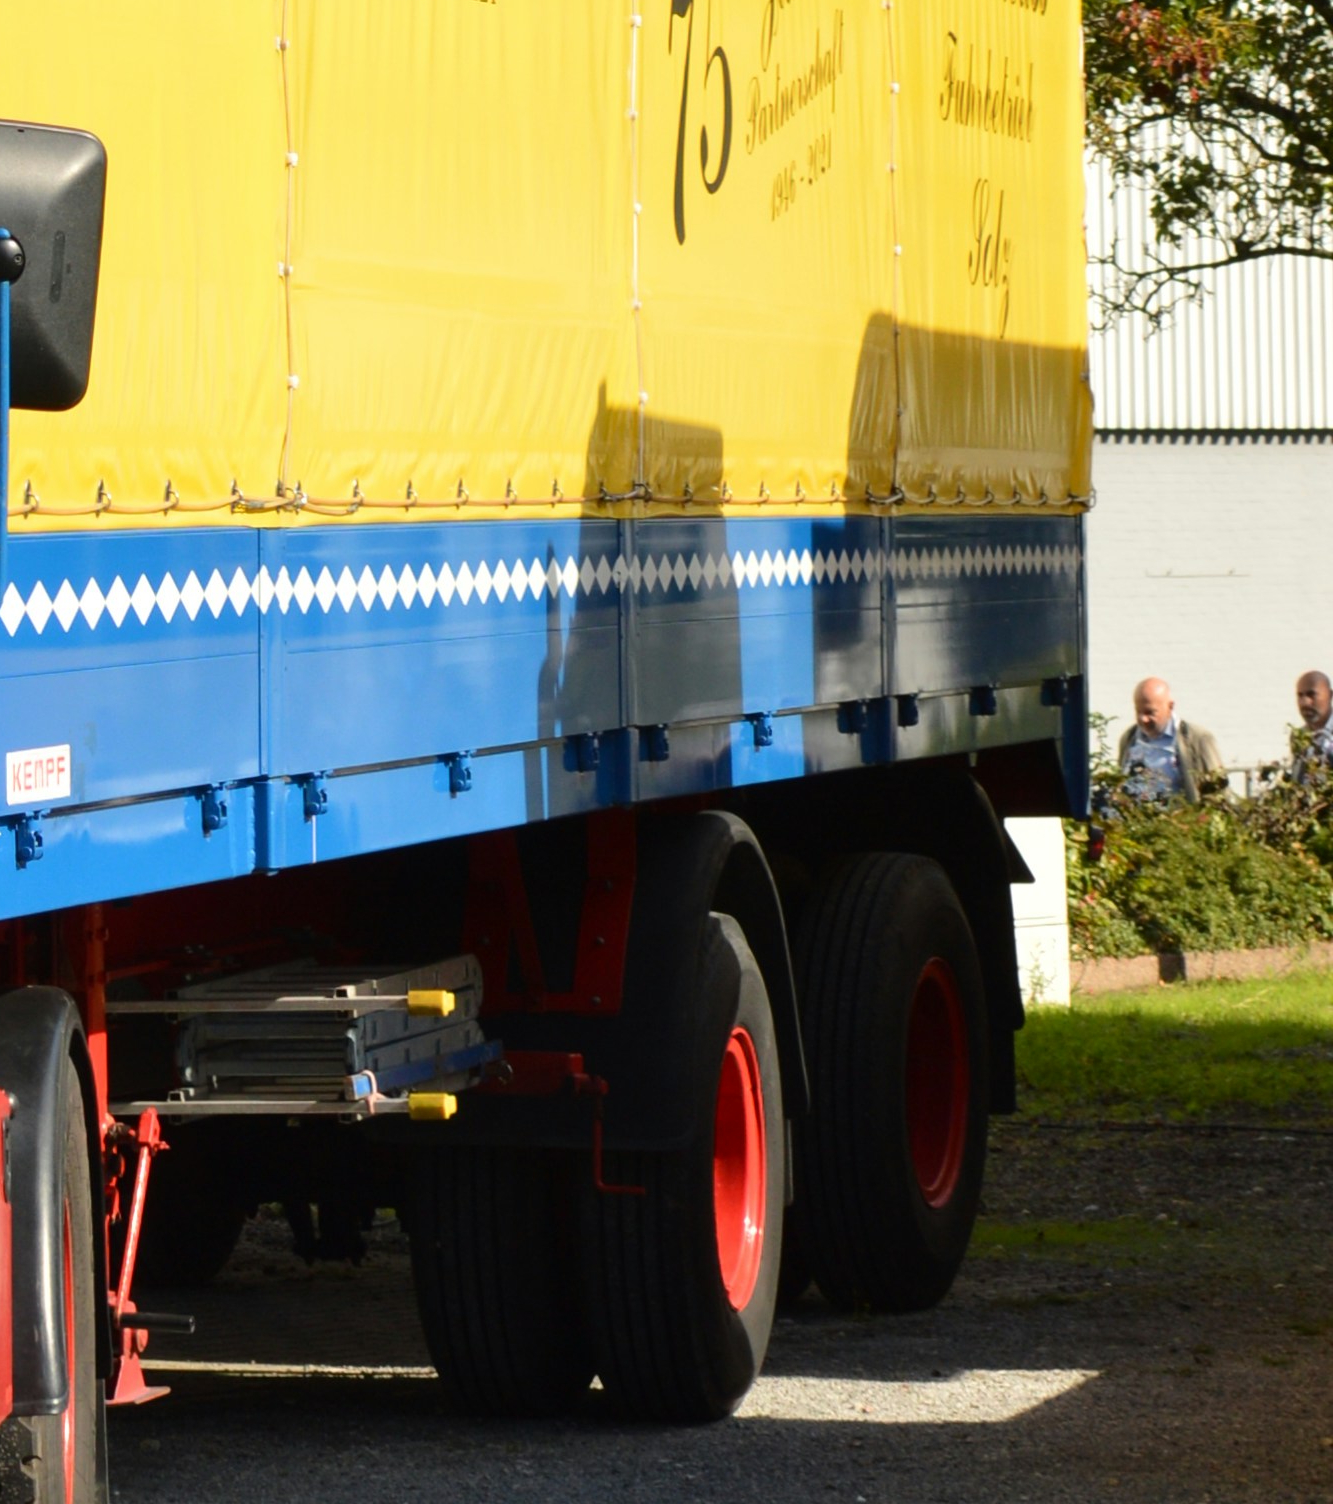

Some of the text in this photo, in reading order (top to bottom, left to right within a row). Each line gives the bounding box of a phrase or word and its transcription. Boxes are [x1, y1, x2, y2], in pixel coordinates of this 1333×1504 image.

[746, 8, 844, 155] Partnerschaft
[940, 30, 1035, 144] Fuhrbetrieb
[968, 178, 1013, 340] Solz
[12, 756, 65, 793] KEMPF
